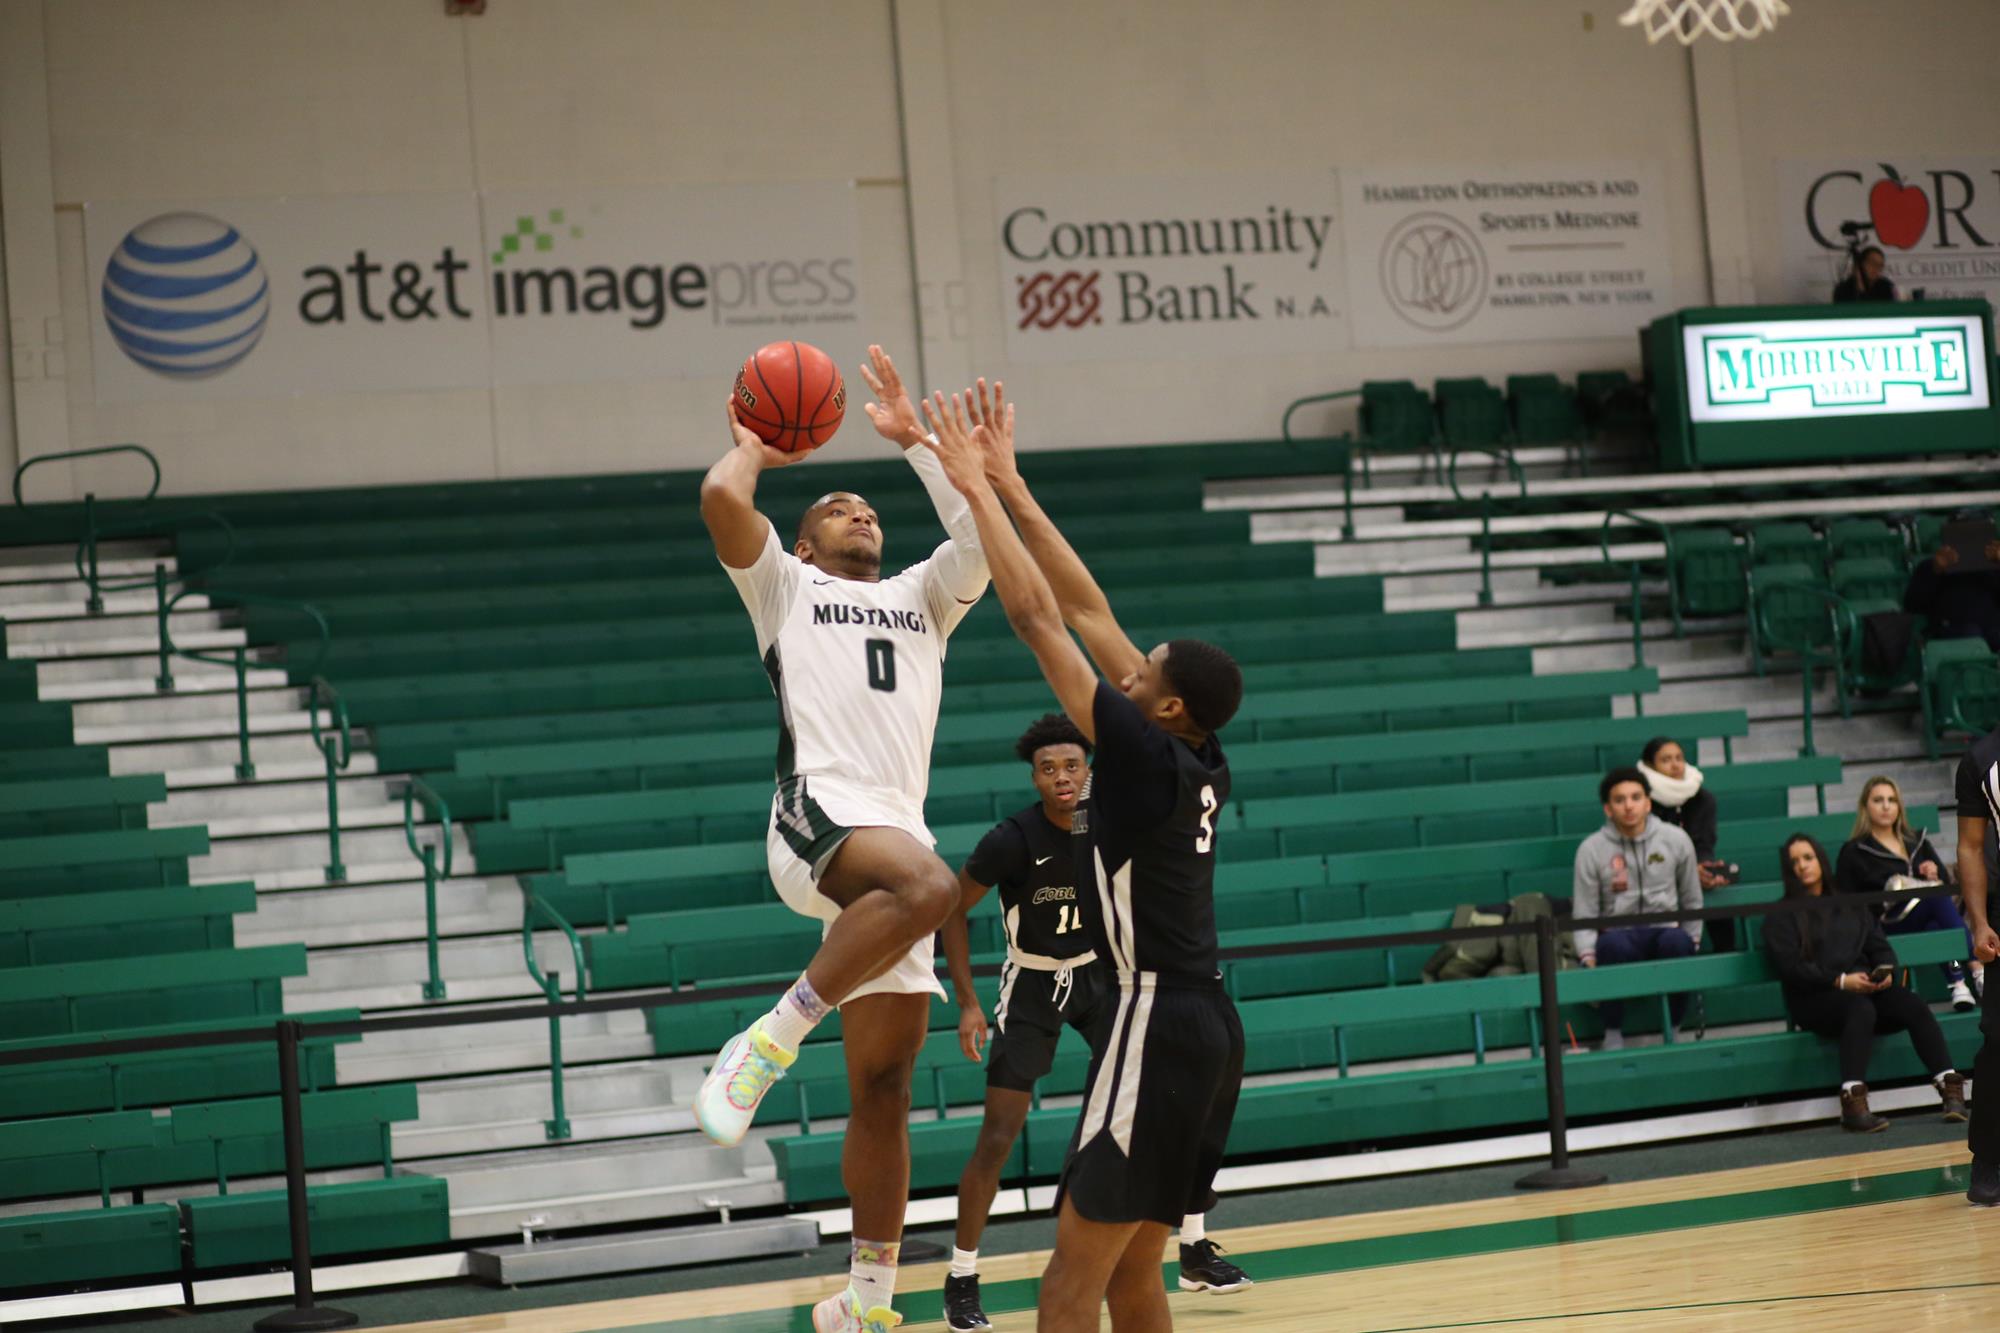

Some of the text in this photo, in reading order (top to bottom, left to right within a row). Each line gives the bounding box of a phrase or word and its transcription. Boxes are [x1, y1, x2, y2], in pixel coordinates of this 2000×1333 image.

[1363, 184, 1458, 201] HAMILTON
[1603, 180, 1639, 197] AND
[1003, 206, 1333, 270] Community
[1479, 210, 1641, 231] SPORTS MEDICINE
[300, 246, 471, 325] at&t
[1115, 264, 1260, 325] Bank
[1716, 340, 1959, 391] MORRISVILLE
[1821, 380, 1873, 397] STATE
[813, 603, 927, 635] MUSTANGS
[865, 638, 897, 693] 0
[1195, 784, 1218, 854] 3
[1032, 886, 1077, 905] COBL
